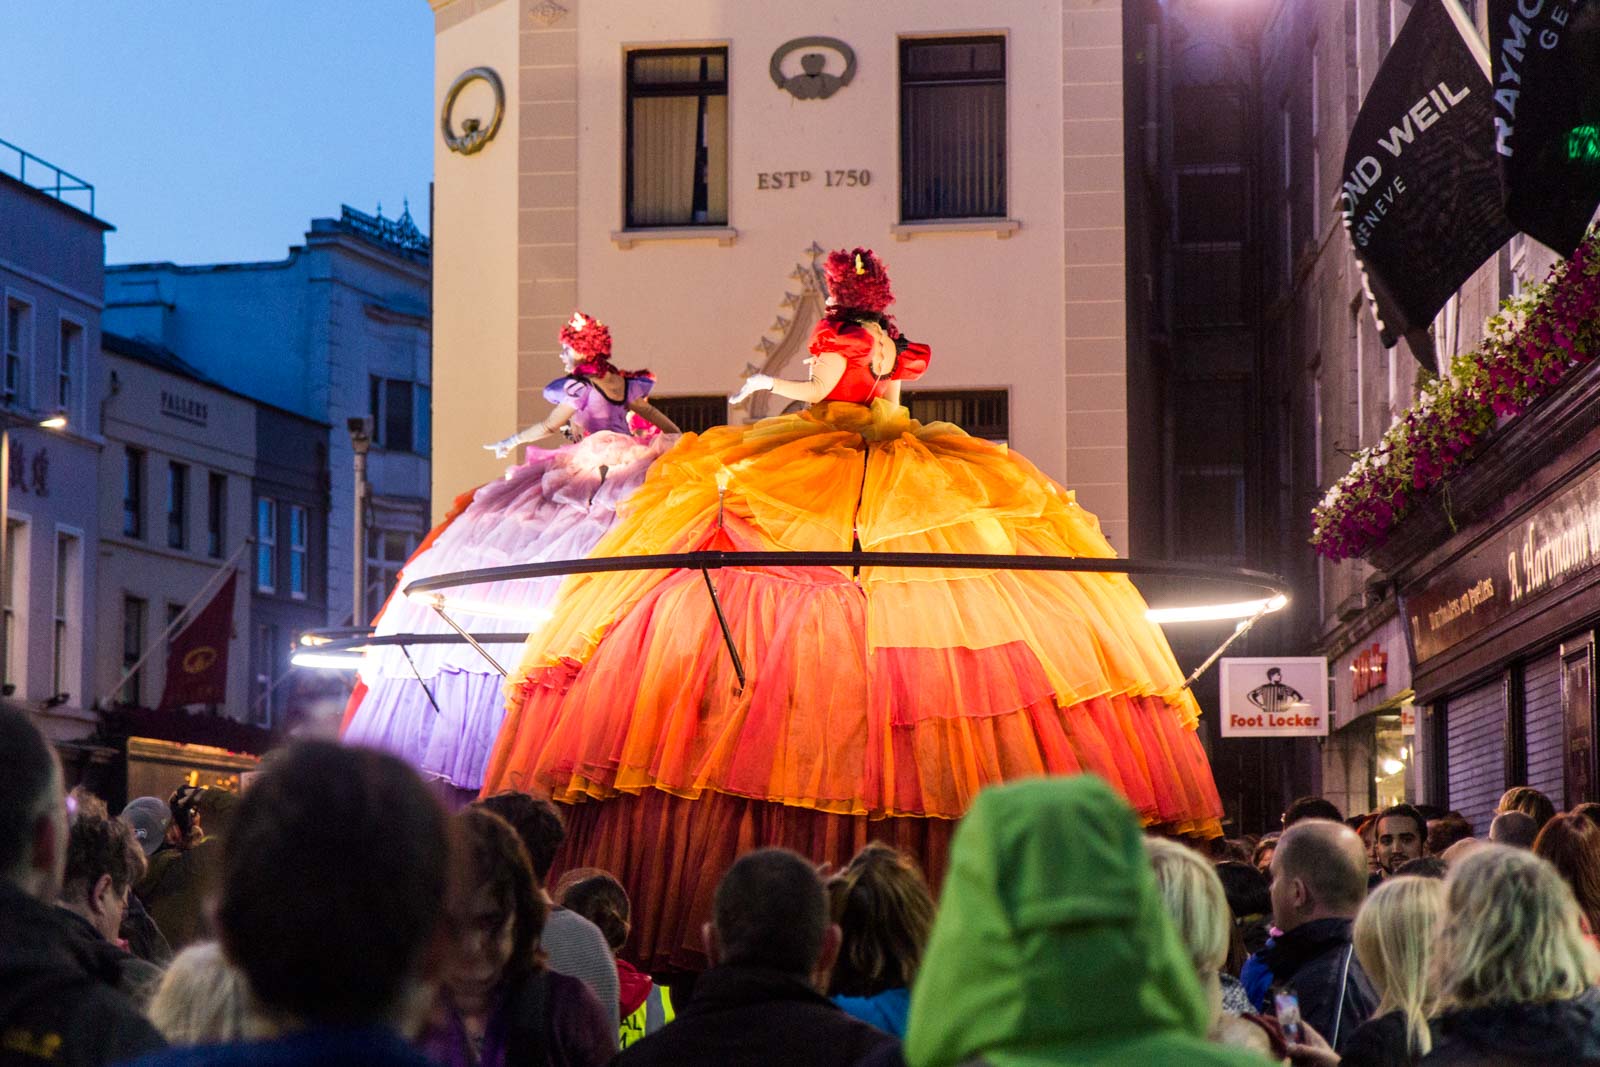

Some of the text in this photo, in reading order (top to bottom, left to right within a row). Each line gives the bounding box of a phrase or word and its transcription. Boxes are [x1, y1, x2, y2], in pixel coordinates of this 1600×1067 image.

[1377, 82, 1471, 157] WEIL
[824, 169, 871, 188] 1750
[1230, 713, 1320, 728] Foot Locker
